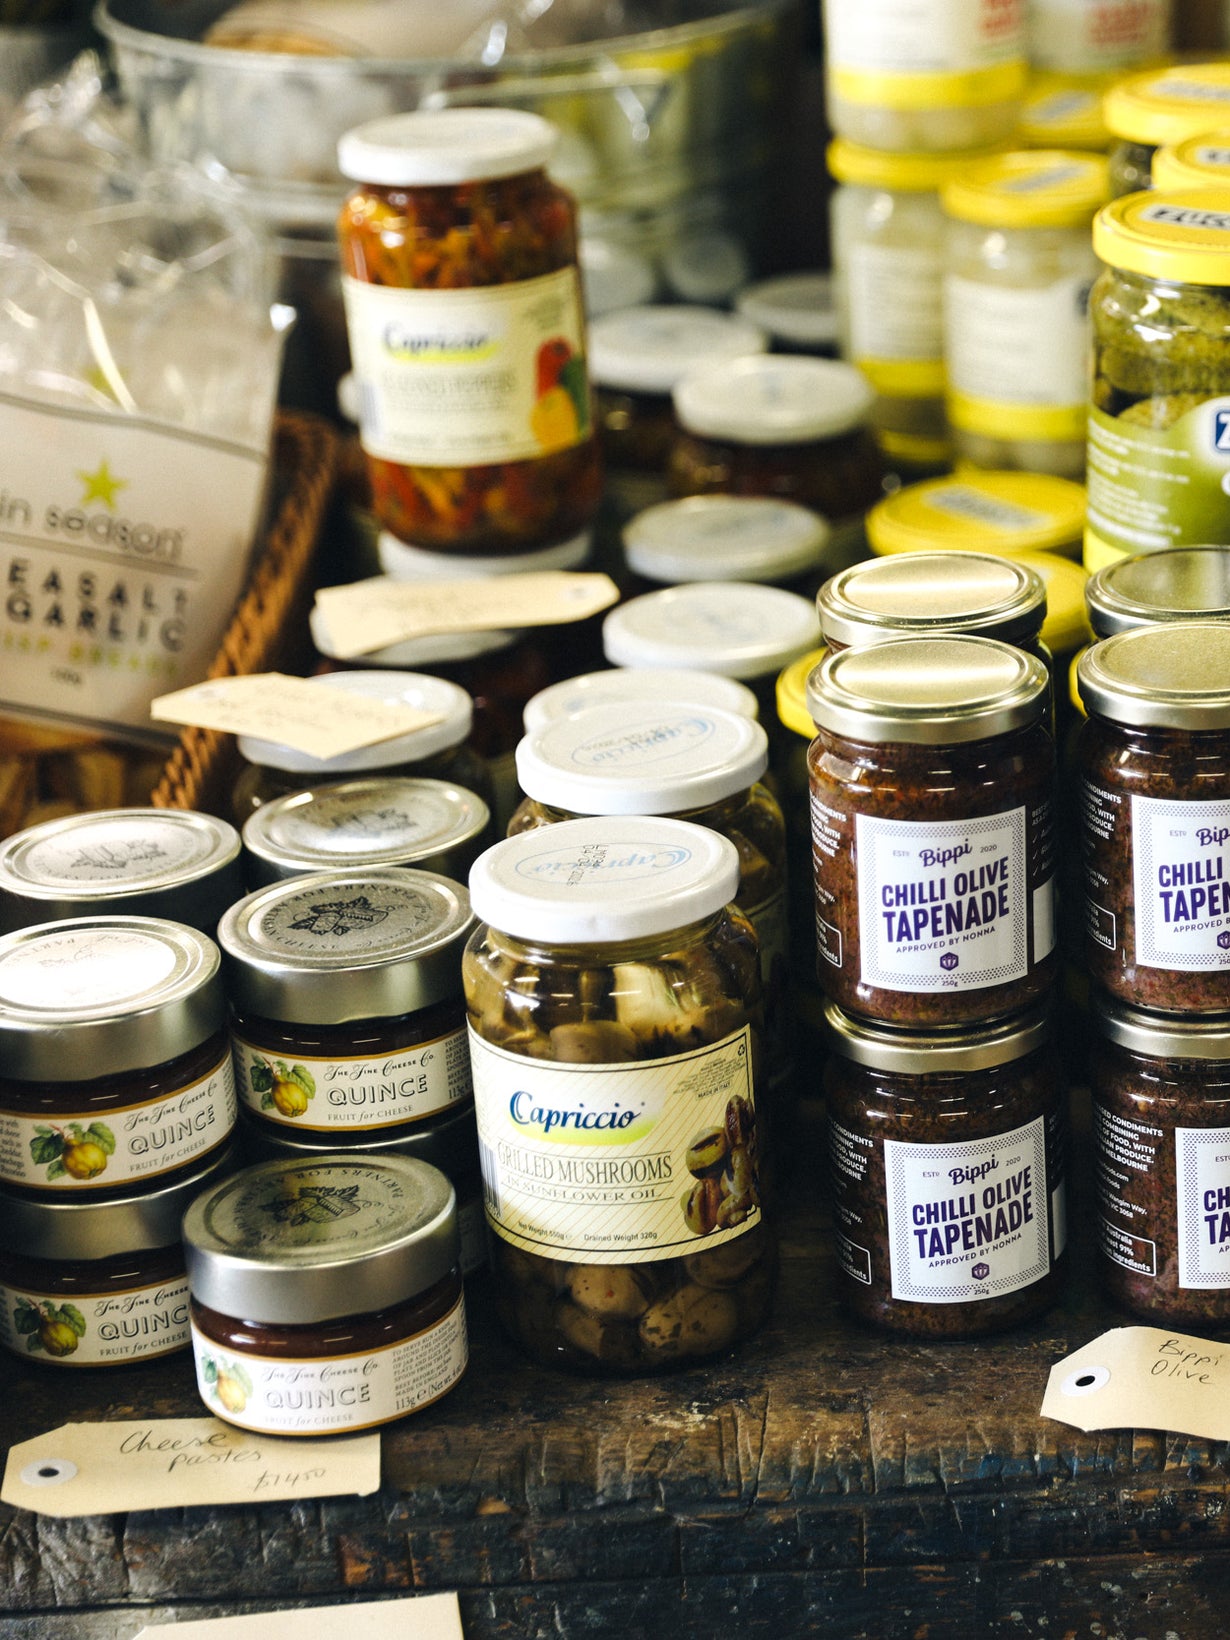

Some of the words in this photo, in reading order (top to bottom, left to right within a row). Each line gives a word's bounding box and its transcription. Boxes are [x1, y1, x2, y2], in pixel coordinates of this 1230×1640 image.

[919, 839, 973, 868] Bippi
[980, 844, 998, 853] 2020
[882, 878, 946, 907] CHILLI
[954, 856, 1009, 897] OLIVE
[1159, 857, 1222, 887] CHILLI
[883, 883, 1010, 943] TAPENADE
[1173, 919, 1222, 933] APPROVED
[897, 940, 945, 953] APPROVED
[949, 937, 960, 946] BY
[963, 926, 995, 942] NONNA
[327, 1074, 428, 1106] QUINCE
[377, 1105, 414, 1118] CHEESE
[510, 1090, 641, 1133] Capriccio
[127, 1104, 216, 1155] QUINCE
[1112, 1115, 1164, 1137] CONDIMENTS
[177, 1138, 206, 1160] CHEESE
[1111, 1132, 1132, 1149] FOOD,
[1133, 1142, 1155, 1155] WITH
[1115, 1145, 1154, 1164] PRODUCE.
[499, 1142, 553, 1180] GRILLED
[558, 1154, 673, 1185] MUSHROOMS
[948, 1154, 999, 1186] Bippi
[1006, 1156, 1021, 1166] 2020
[1106, 1148, 1148, 1172] MELBOURNE
[522, 1181, 625, 1202] SUNFLOWER
[630, 1189, 660, 1199] OIL
[912, 1194, 976, 1226] CHILLI
[983, 1165, 1032, 1209] OLIVE
[614, 1233, 638, 1241] Weight
[640, 1232, 657, 1240] 320g
[914, 1191, 1033, 1259] TAPENADE
[929, 1253, 977, 1268] APPROVED
[980, 1248, 989, 1256] BY
[993, 1233, 1021, 1251] NONNA
[150, 1332, 187, 1347] CHEESE
[1159, 1338, 1220, 1367] Bippi
[1151, 1360, 1214, 1385] Olive
[265, 1384, 371, 1410] QUINCE
[316, 1413, 354, 1425] CHEESE
[120, 1430, 227, 1454] Cheese
